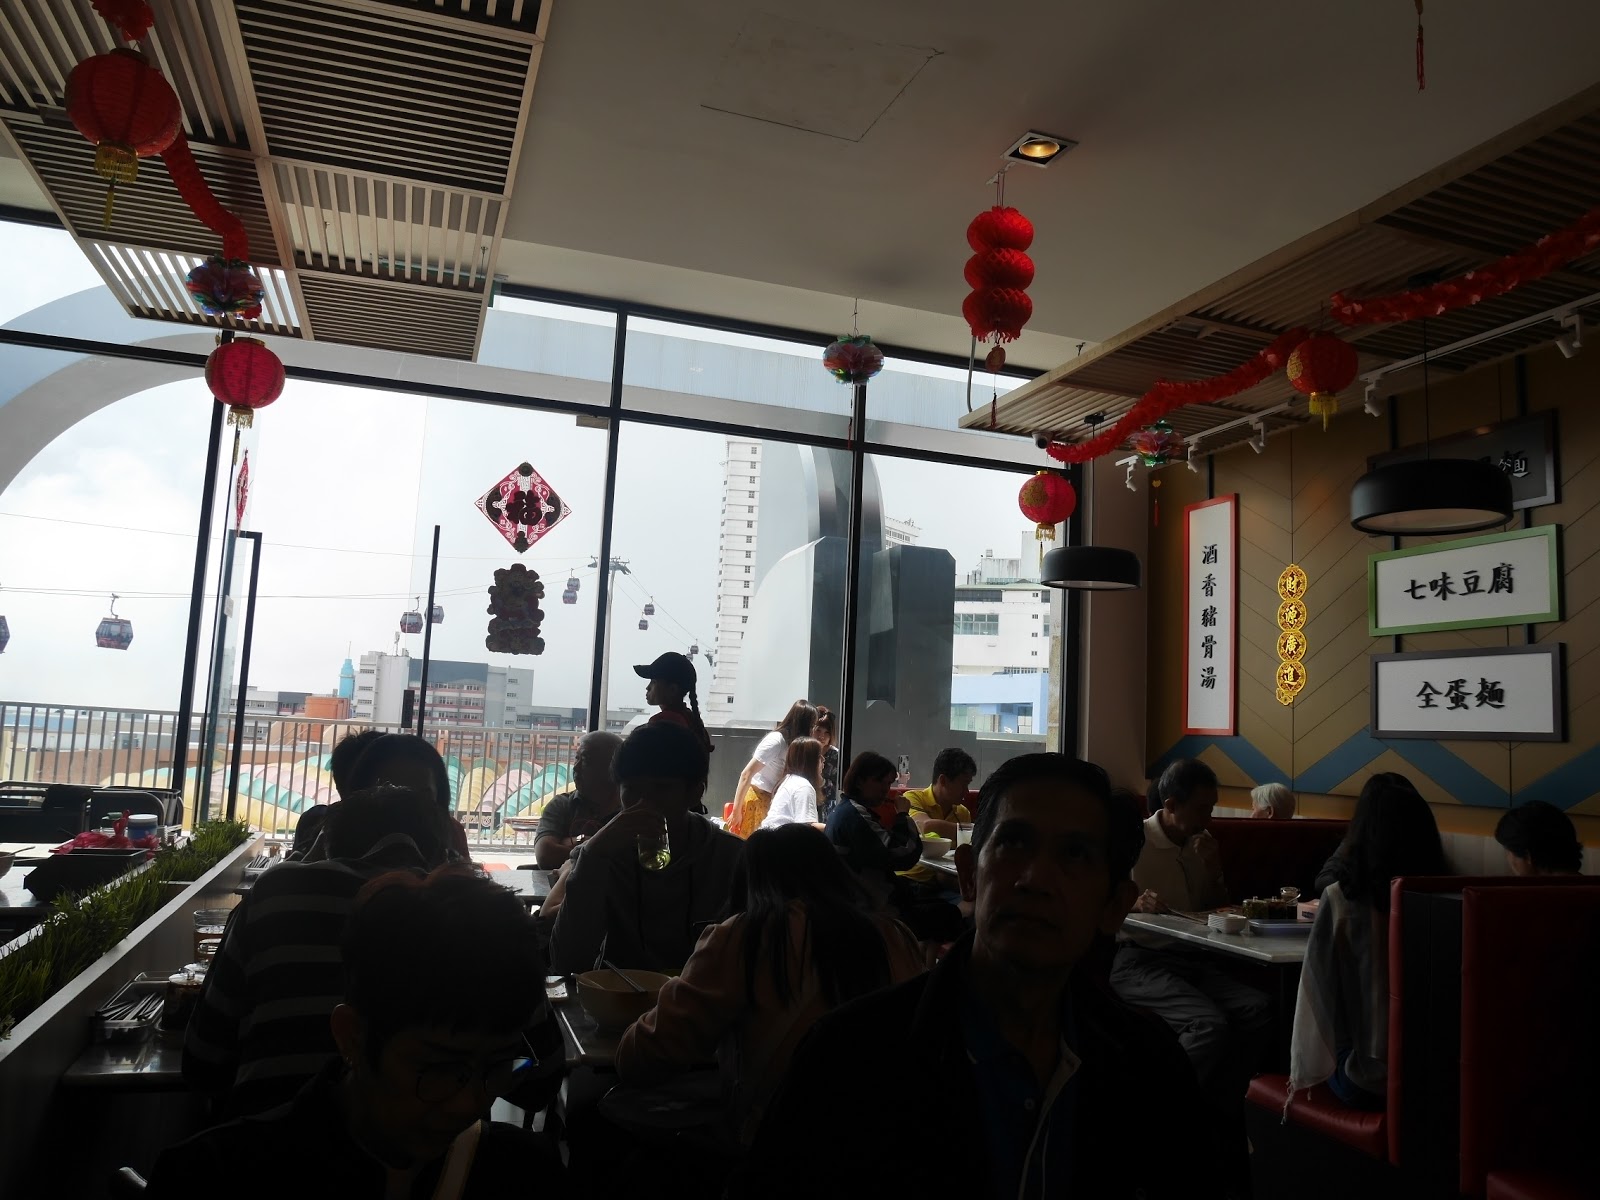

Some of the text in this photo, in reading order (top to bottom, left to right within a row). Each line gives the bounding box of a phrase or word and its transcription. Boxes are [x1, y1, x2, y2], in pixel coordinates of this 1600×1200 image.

[1403, 562, 1515, 601] 七味豆腐
[1200, 543, 1218, 690] 酒香豬骨湯
[1416, 677, 1506, 711] 全蛋麵
